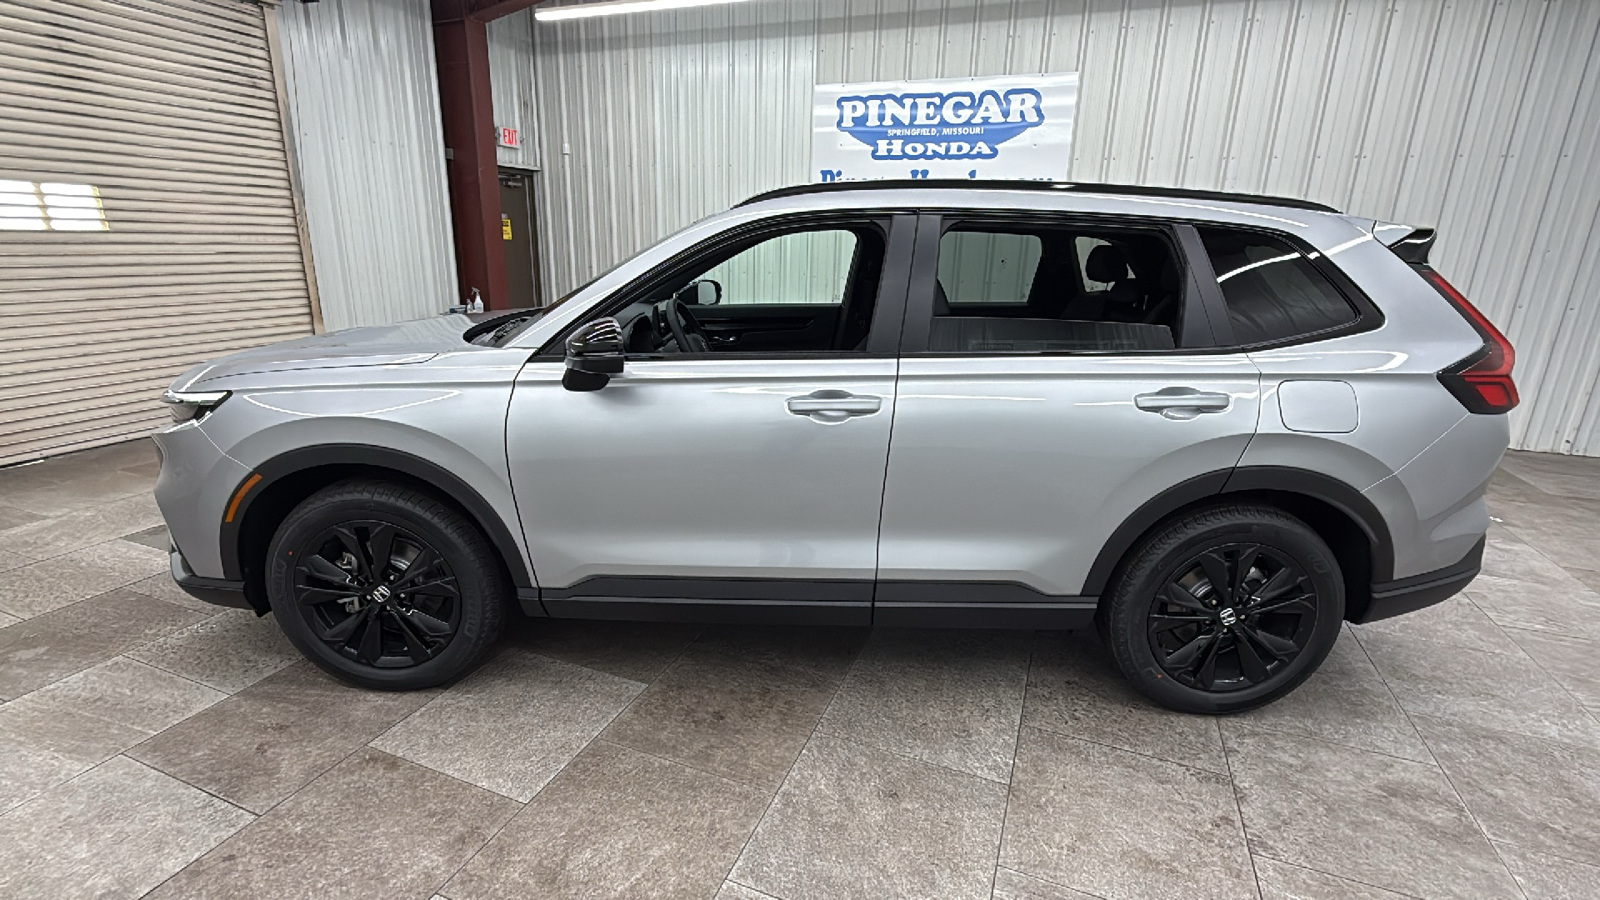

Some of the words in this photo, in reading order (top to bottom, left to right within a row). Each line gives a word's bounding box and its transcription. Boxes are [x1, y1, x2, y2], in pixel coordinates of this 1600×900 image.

[841, 93, 1040, 127] PINEGAR
[502, 127, 517, 146] EXIT
[887, 128, 940, 137] SPRINGFIELD,
[941, 127, 984, 136] MISSOURI
[876, 139, 994, 156] HONDA
